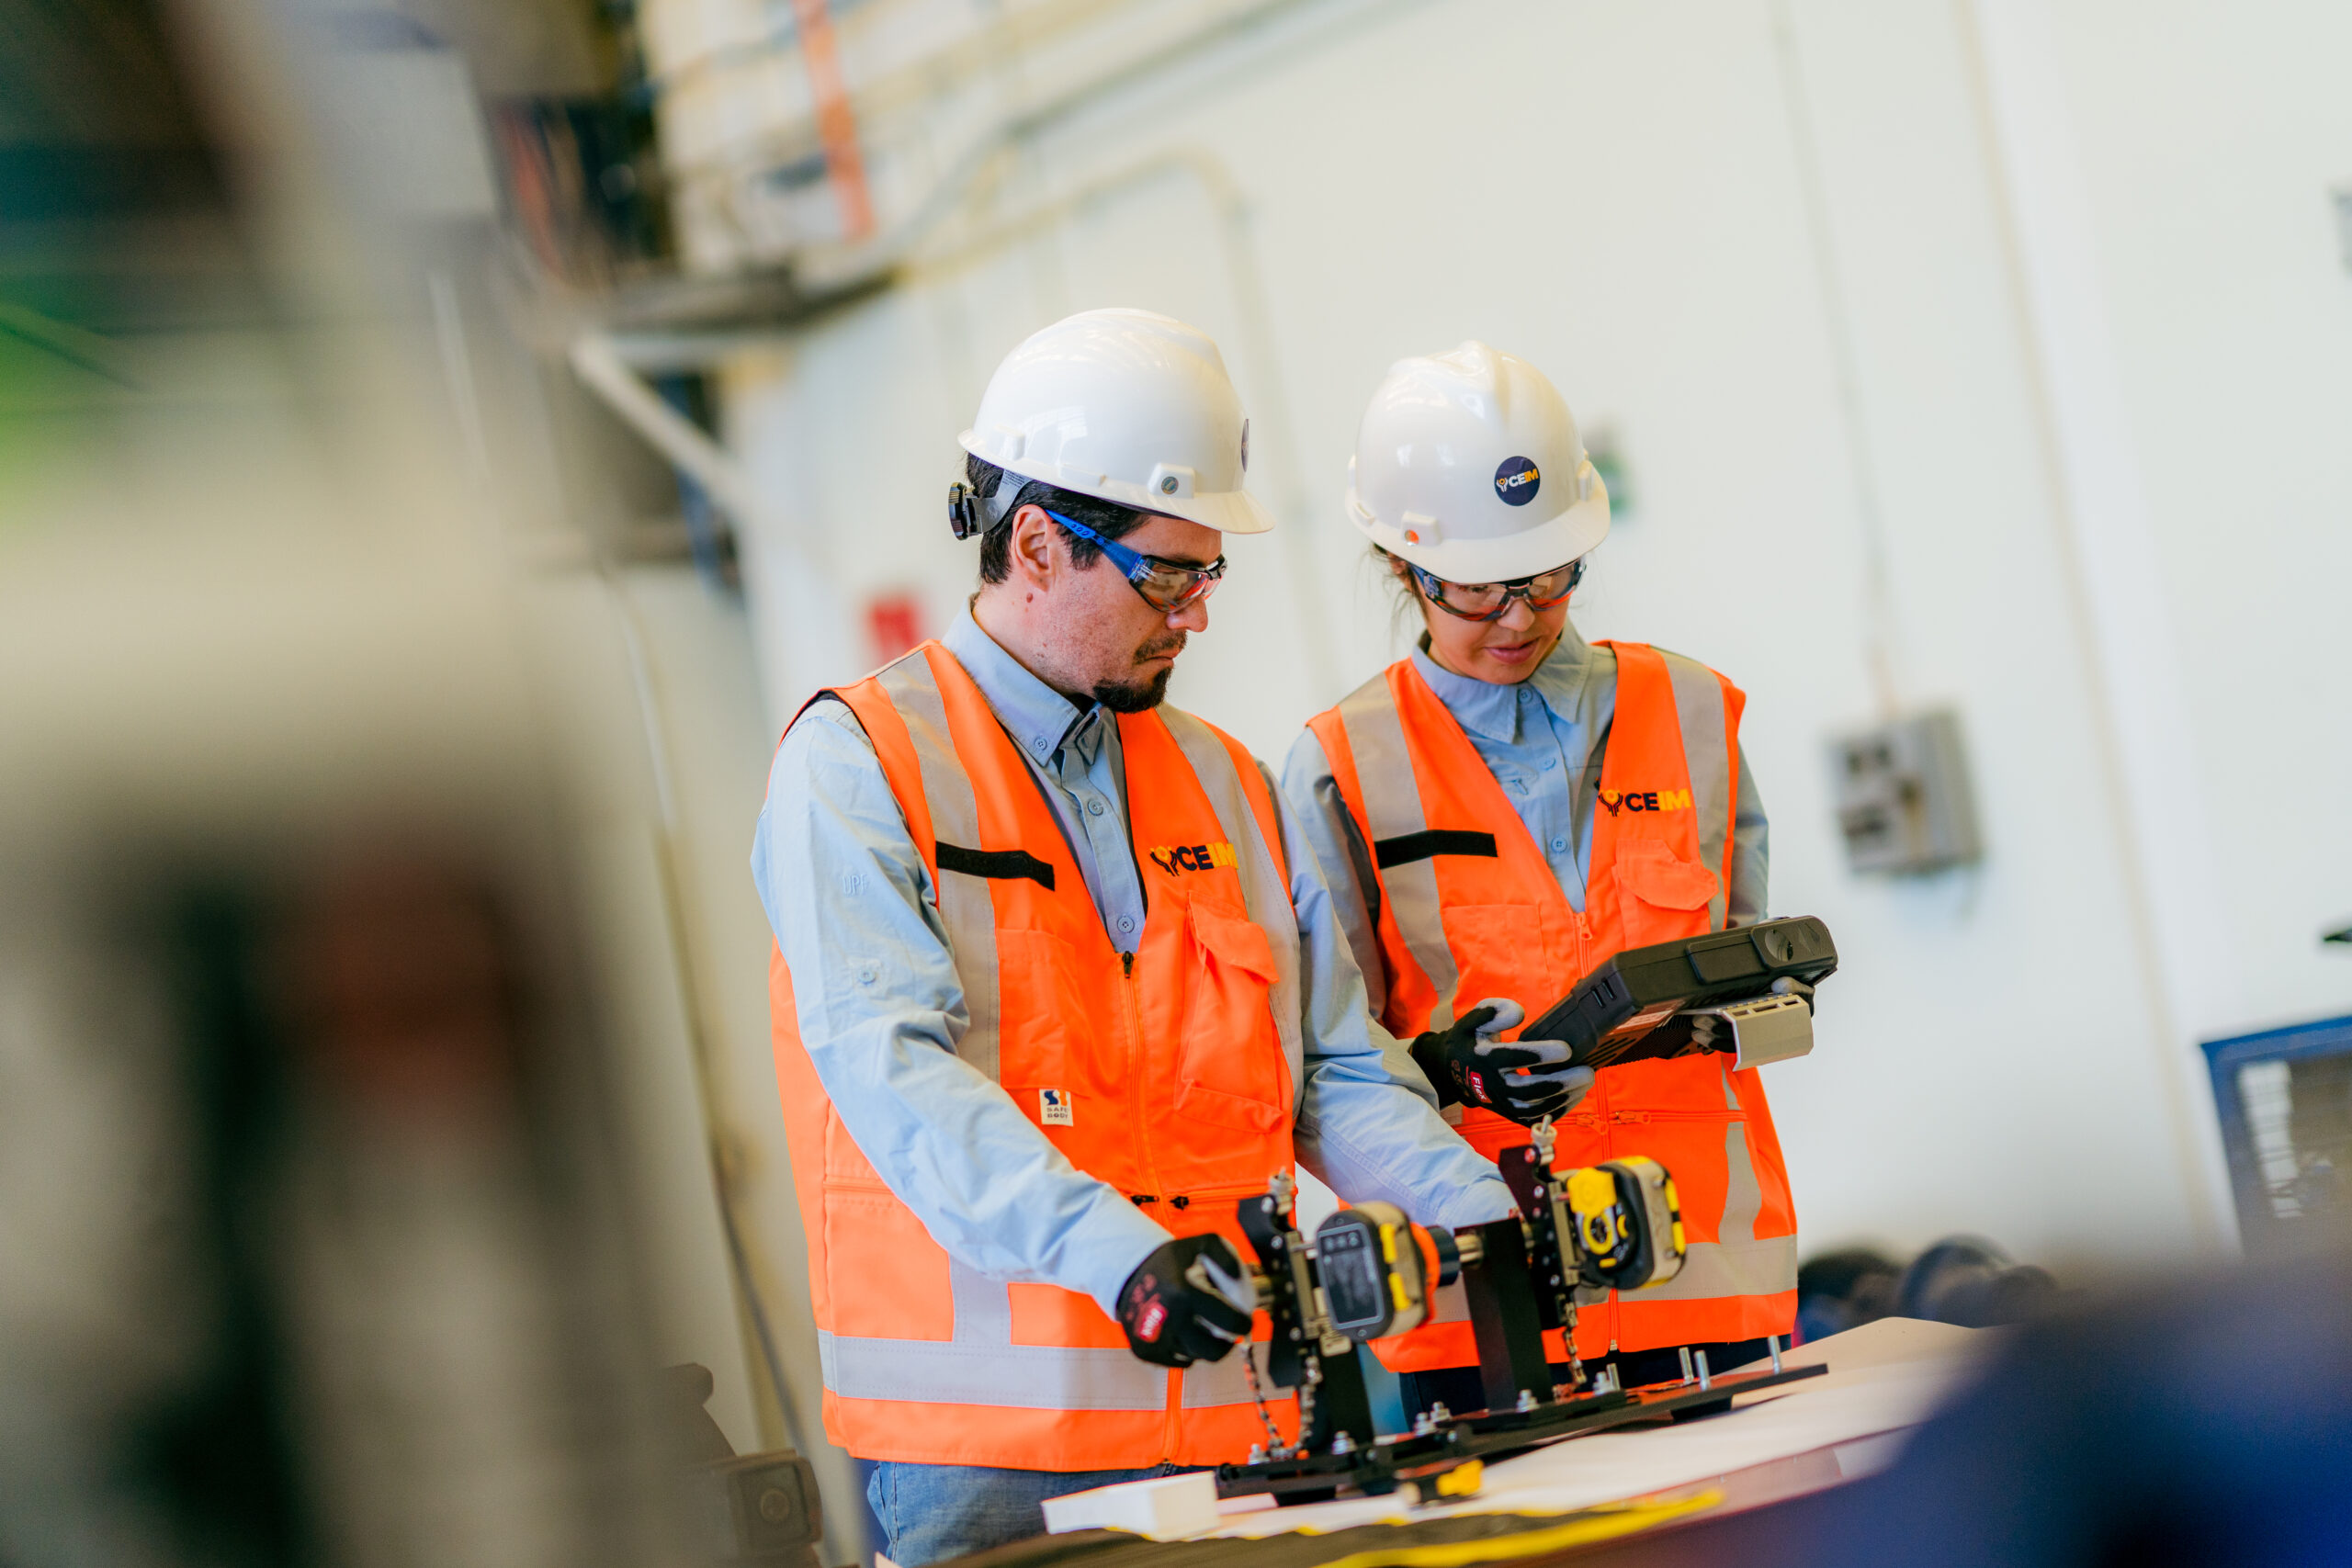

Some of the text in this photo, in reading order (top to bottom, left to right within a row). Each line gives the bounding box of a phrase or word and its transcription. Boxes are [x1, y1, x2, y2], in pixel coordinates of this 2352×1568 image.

[1509, 468, 1539, 488] CEIM
[1624, 788, 1691, 812] CEIM
[1176, 842, 1238, 872] CEIM
[1472, 1077, 1487, 1100] Flex
